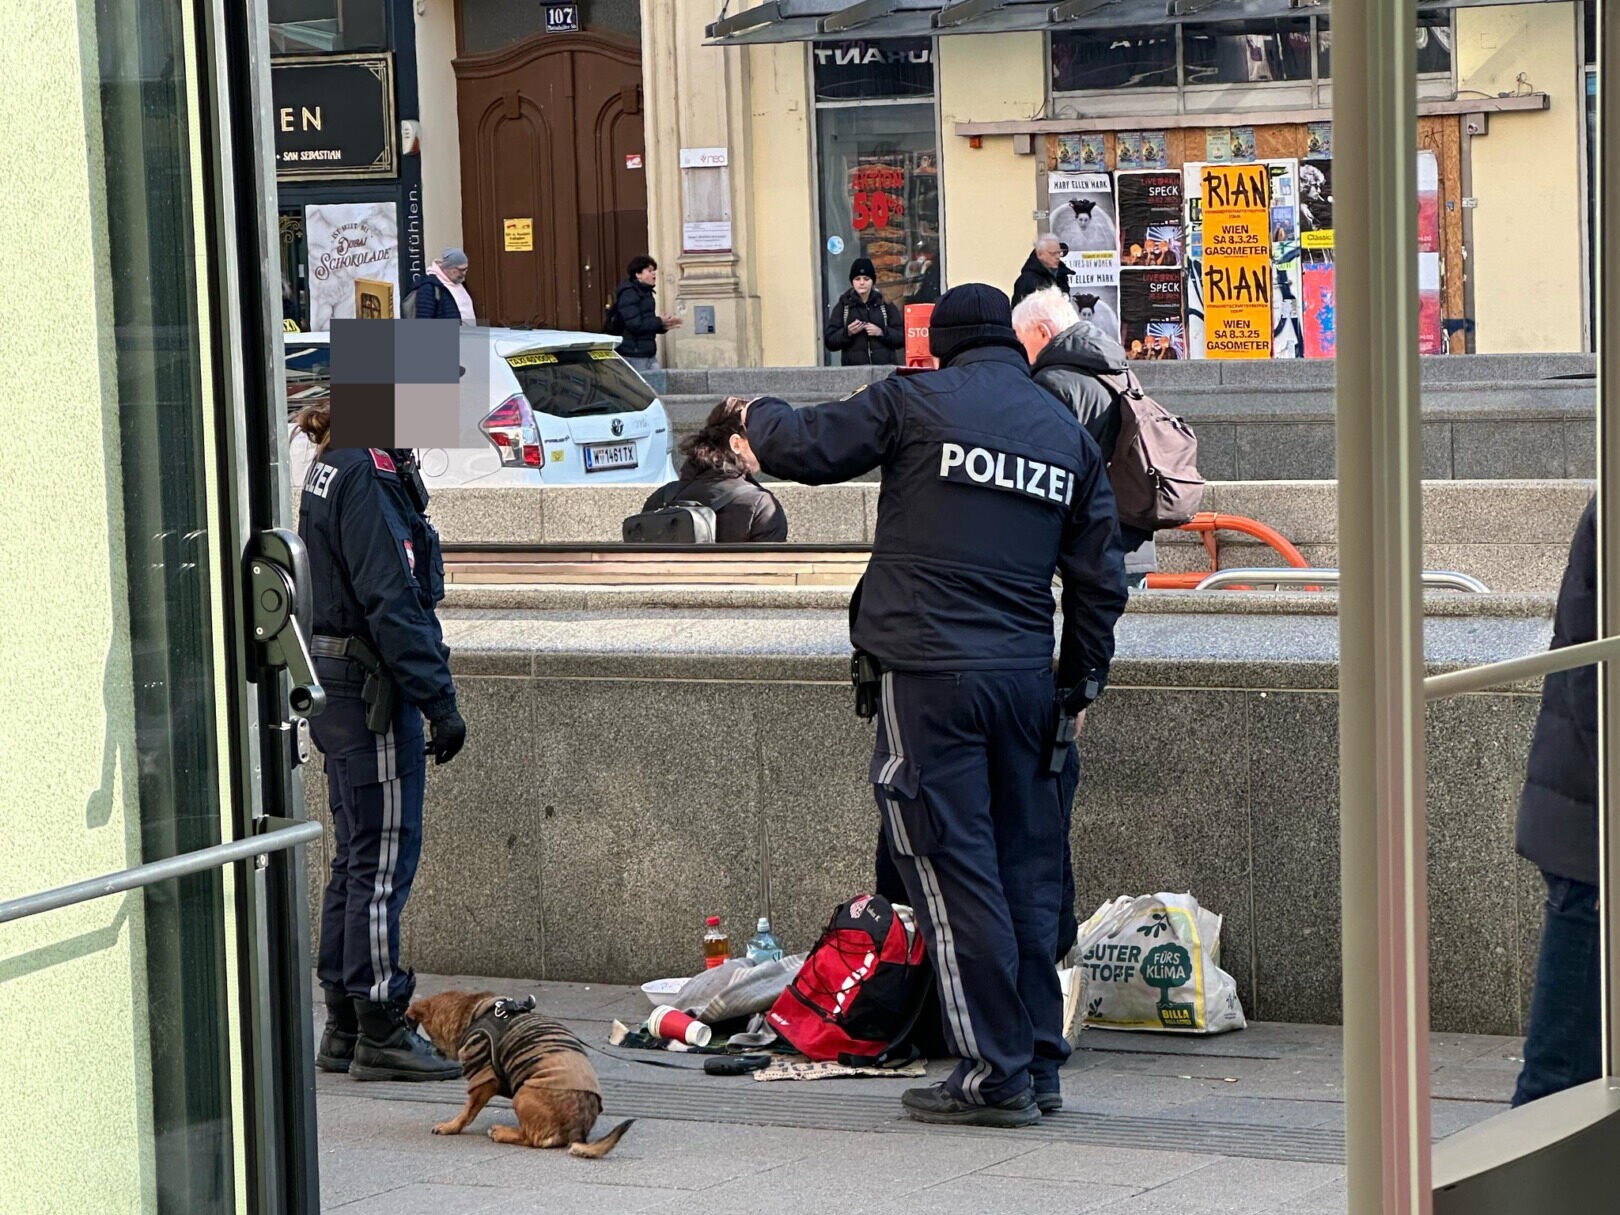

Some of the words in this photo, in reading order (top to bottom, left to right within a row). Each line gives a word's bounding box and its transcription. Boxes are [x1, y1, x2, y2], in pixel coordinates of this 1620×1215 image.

[549, 8, 573, 25] 107
[280, 106, 321, 132] EN
[283, 151, 298, 161] SAN
[300, 150, 341, 160] SEBASTIAN
[1054, 180, 1069, 190] MARY
[1071, 180, 1089, 189] ELLEN
[1203, 170, 1267, 208] RIAN
[1149, 186, 1179, 196] SPECK
[853, 191, 904, 231] 50%
[1222, 225, 1249, 234] WIEN
[1213, 235, 1227, 244] SA
[1228, 235, 1259, 245] 8.3.25
[1204, 246, 1268, 256] GASOMETER
[1150, 282, 1180, 293] SPECK
[1205, 265, 1269, 303] RIAN
[1223, 320, 1250, 329] WIEN
[1214, 330, 1228, 339] SA
[1229, 330, 1260, 339] 8.3.25
[1206, 341, 1269, 351] GASOMETER
[593, 449, 600, 464] W
[939, 442, 1075, 506] POLIZEI
[1154, 950, 1181, 965] FÜRS
[1162, 1009, 1190, 1019] BILLA
